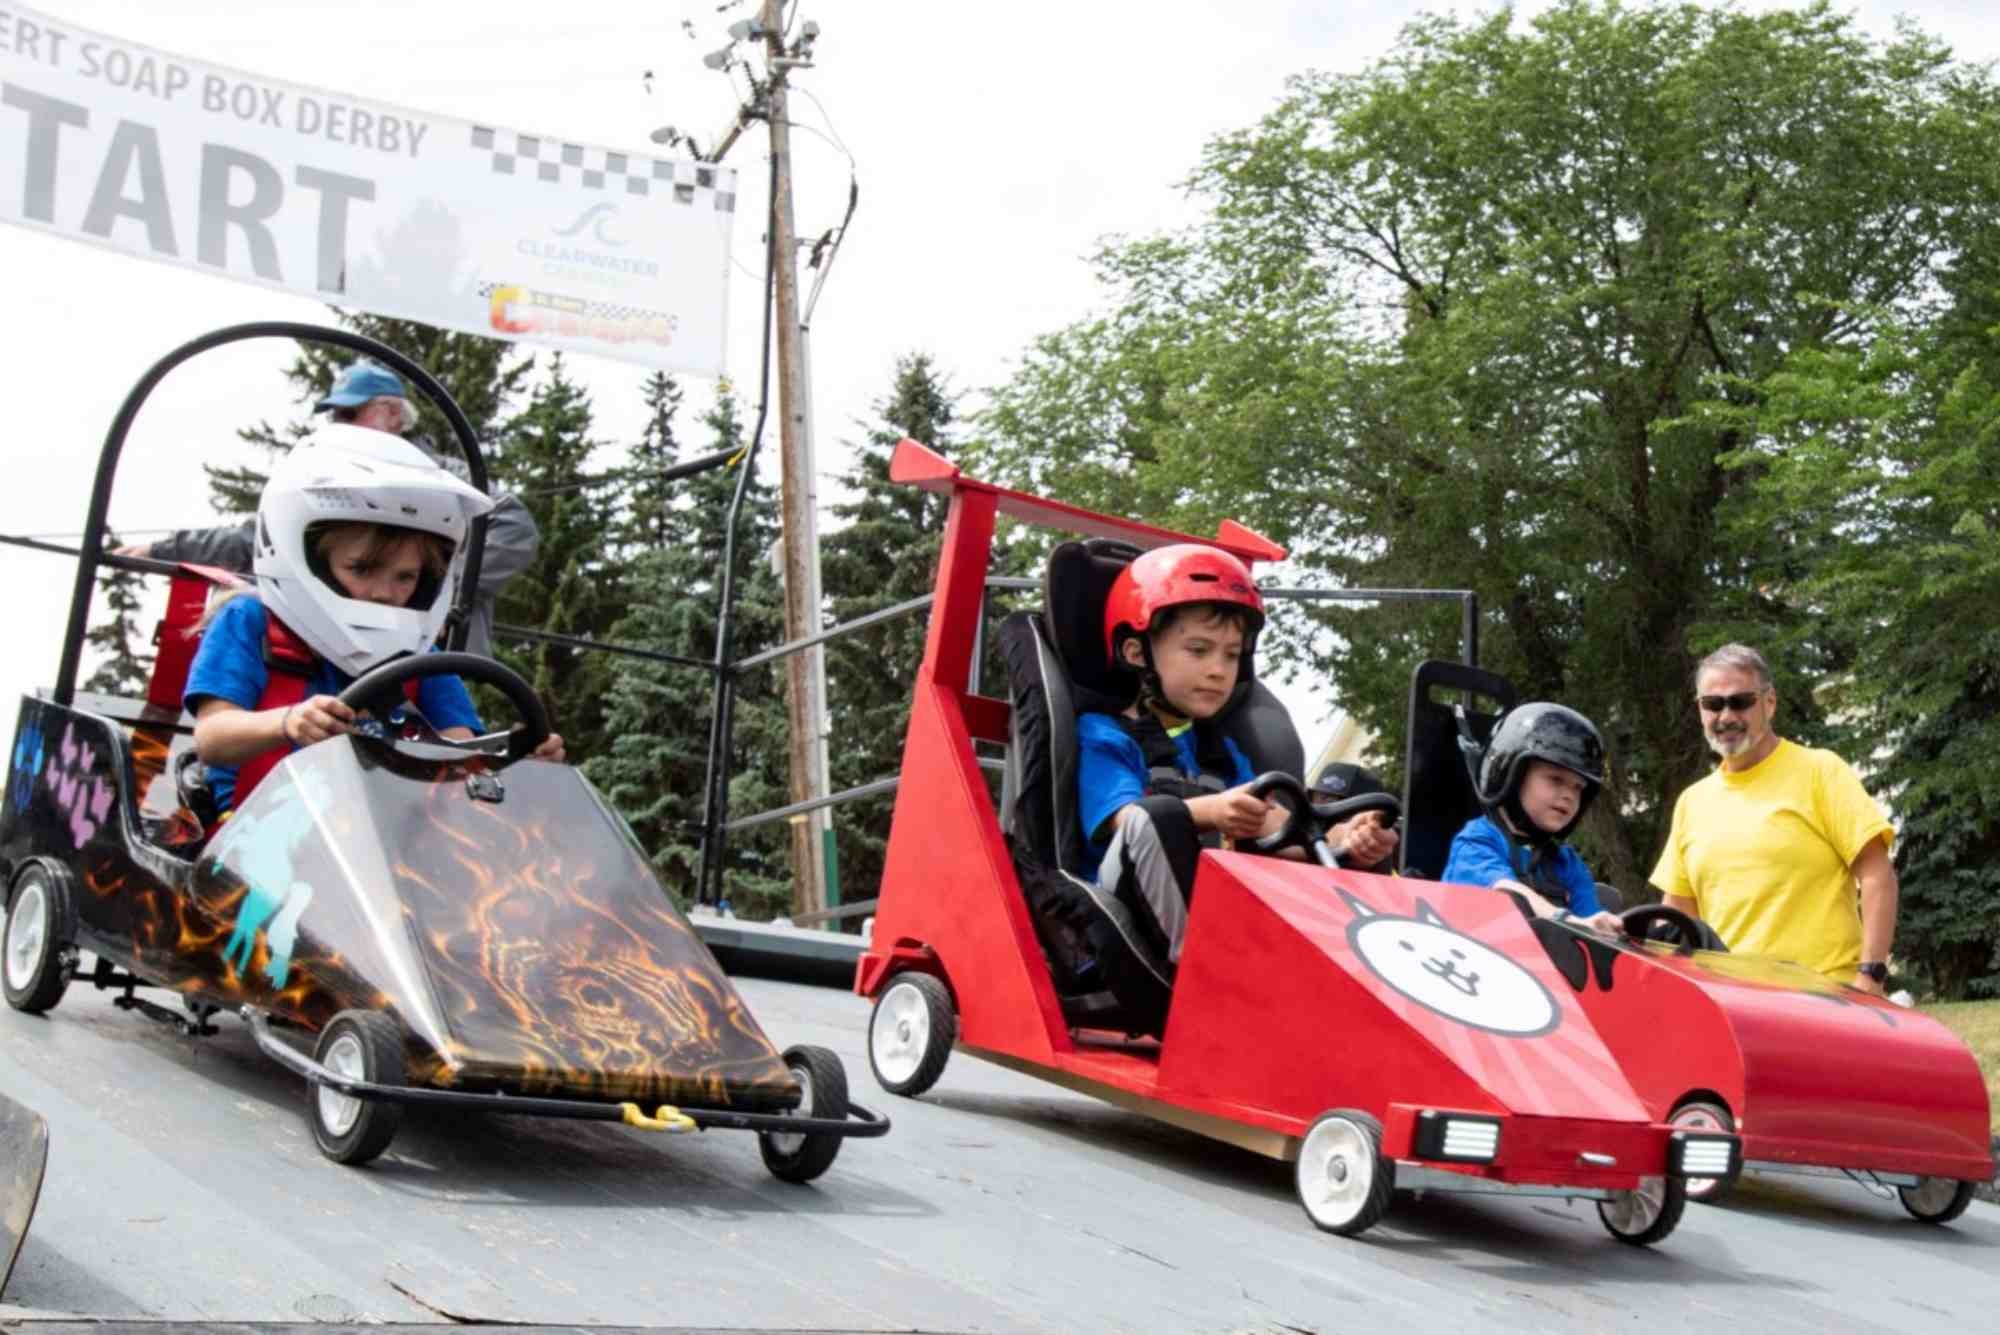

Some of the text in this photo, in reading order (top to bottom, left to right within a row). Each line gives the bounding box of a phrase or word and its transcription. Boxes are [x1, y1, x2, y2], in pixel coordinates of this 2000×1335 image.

[78, 42, 191, 101] SOAP
[201, 73, 285, 129] BOX
[295, 96, 428, 158] DERBY
[2, 81, 376, 295] TART
[516, 238, 660, 277] CLEARWATER
